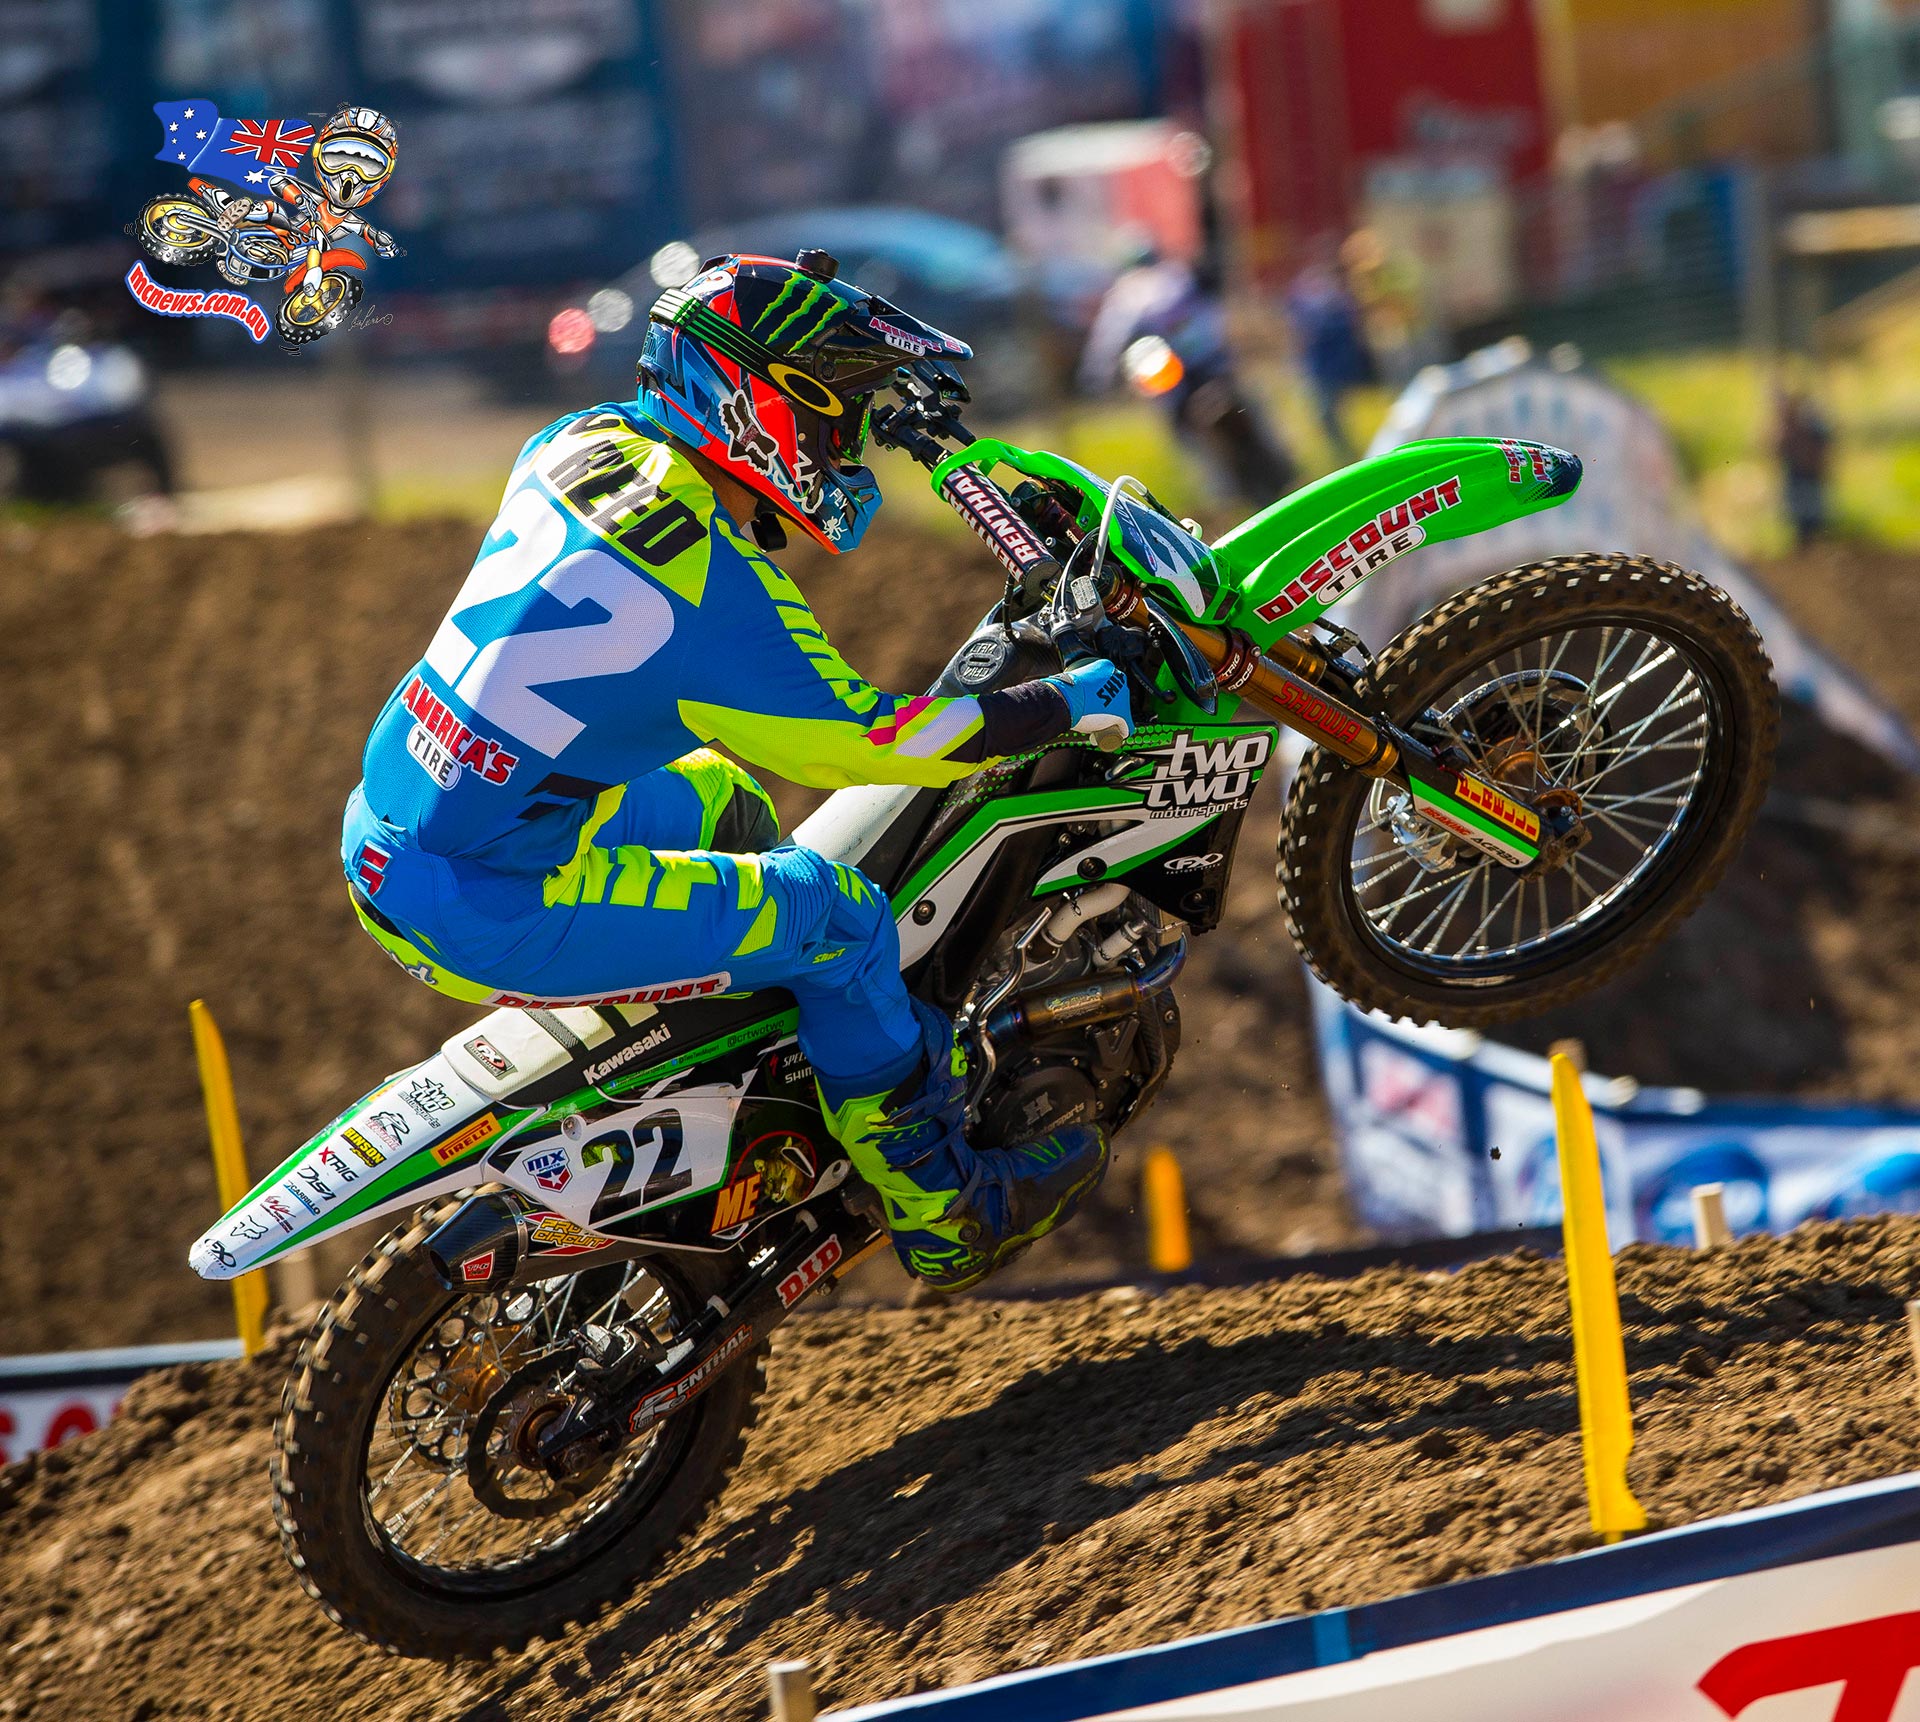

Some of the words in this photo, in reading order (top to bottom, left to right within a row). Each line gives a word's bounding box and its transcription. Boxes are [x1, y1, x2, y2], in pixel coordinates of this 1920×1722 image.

[890, 336, 920, 352] TIRE
[547, 439, 708, 567] REED
[829, 487, 848, 510] FLY
[947, 467, 1041, 564] RENTHAL
[1256, 477, 1460, 621] DISCOUNT
[1326, 532, 1413, 594] TIRE
[423, 487, 675, 760] 22
[1105, 593, 1127, 614] XTRIG
[1117, 596, 1139, 621] ROCS
[1216, 652, 1241, 683] XTRIG
[1227, 661, 1255, 691] ROCS
[402, 676, 517, 784] AMERICA'S
[1272, 680, 1362, 745] SHOWA
[414, 730, 454, 784] TIRE
[1140, 733, 1270, 776] two
[1146, 765, 1251, 808] two
[1458, 777, 1537, 838] PIRELLI
[1150, 798, 1249, 819] motorsports
[1421, 806, 1472, 836] BRAKING
[495, 978, 721, 1009] DIOUNT
[582, 1023, 672, 1086] Kawasaki
[342, 1126, 386, 1165] HINSON
[437, 1119, 493, 1161] PIRELLI
[318, 1146, 360, 1182] XTRIG
[580, 1107, 693, 1226] 22
[289, 1183, 321, 1216] CARRILLO
[710, 1172, 762, 1234] ME
[532, 1228, 606, 1248] CIRCUIT
[540, 1218, 582, 1234] PRO
